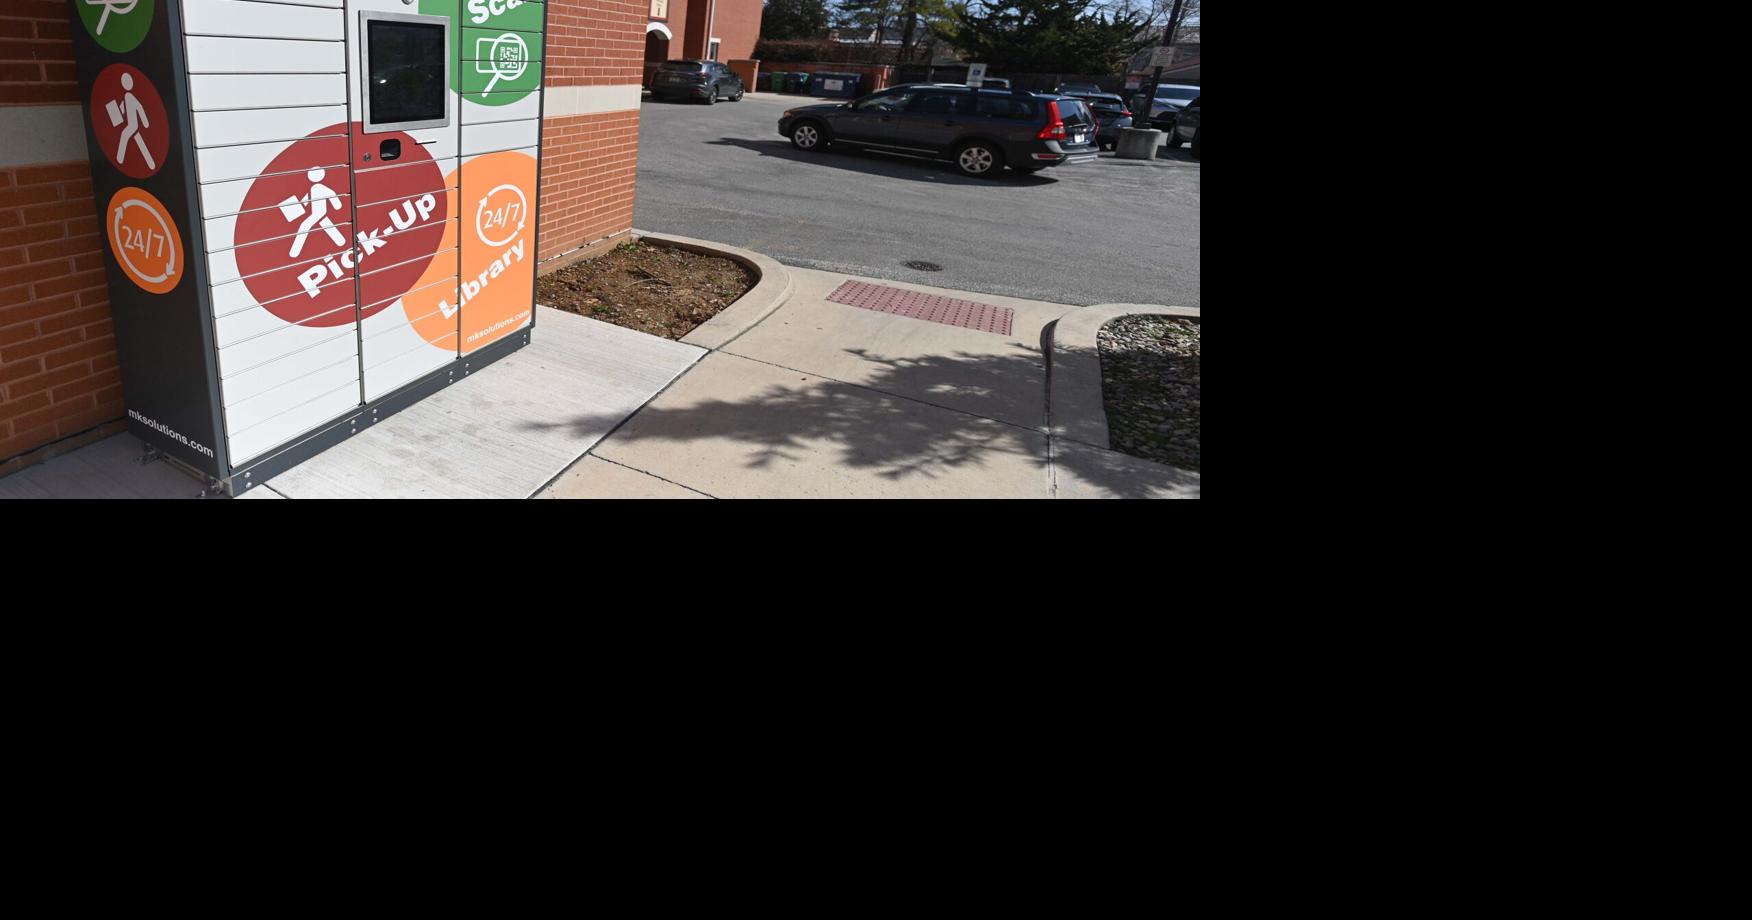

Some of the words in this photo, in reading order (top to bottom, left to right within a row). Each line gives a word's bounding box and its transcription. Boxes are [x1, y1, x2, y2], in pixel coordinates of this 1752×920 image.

[484, 202, 520, 230] 24/7
[122, 223, 165, 260] 24/7
[296, 193, 436, 299] Pick-Up
[438, 238, 525, 320] Library
[467, 310, 530, 343] mksolutions.com
[127, 408, 214, 459] mksolutions.com
